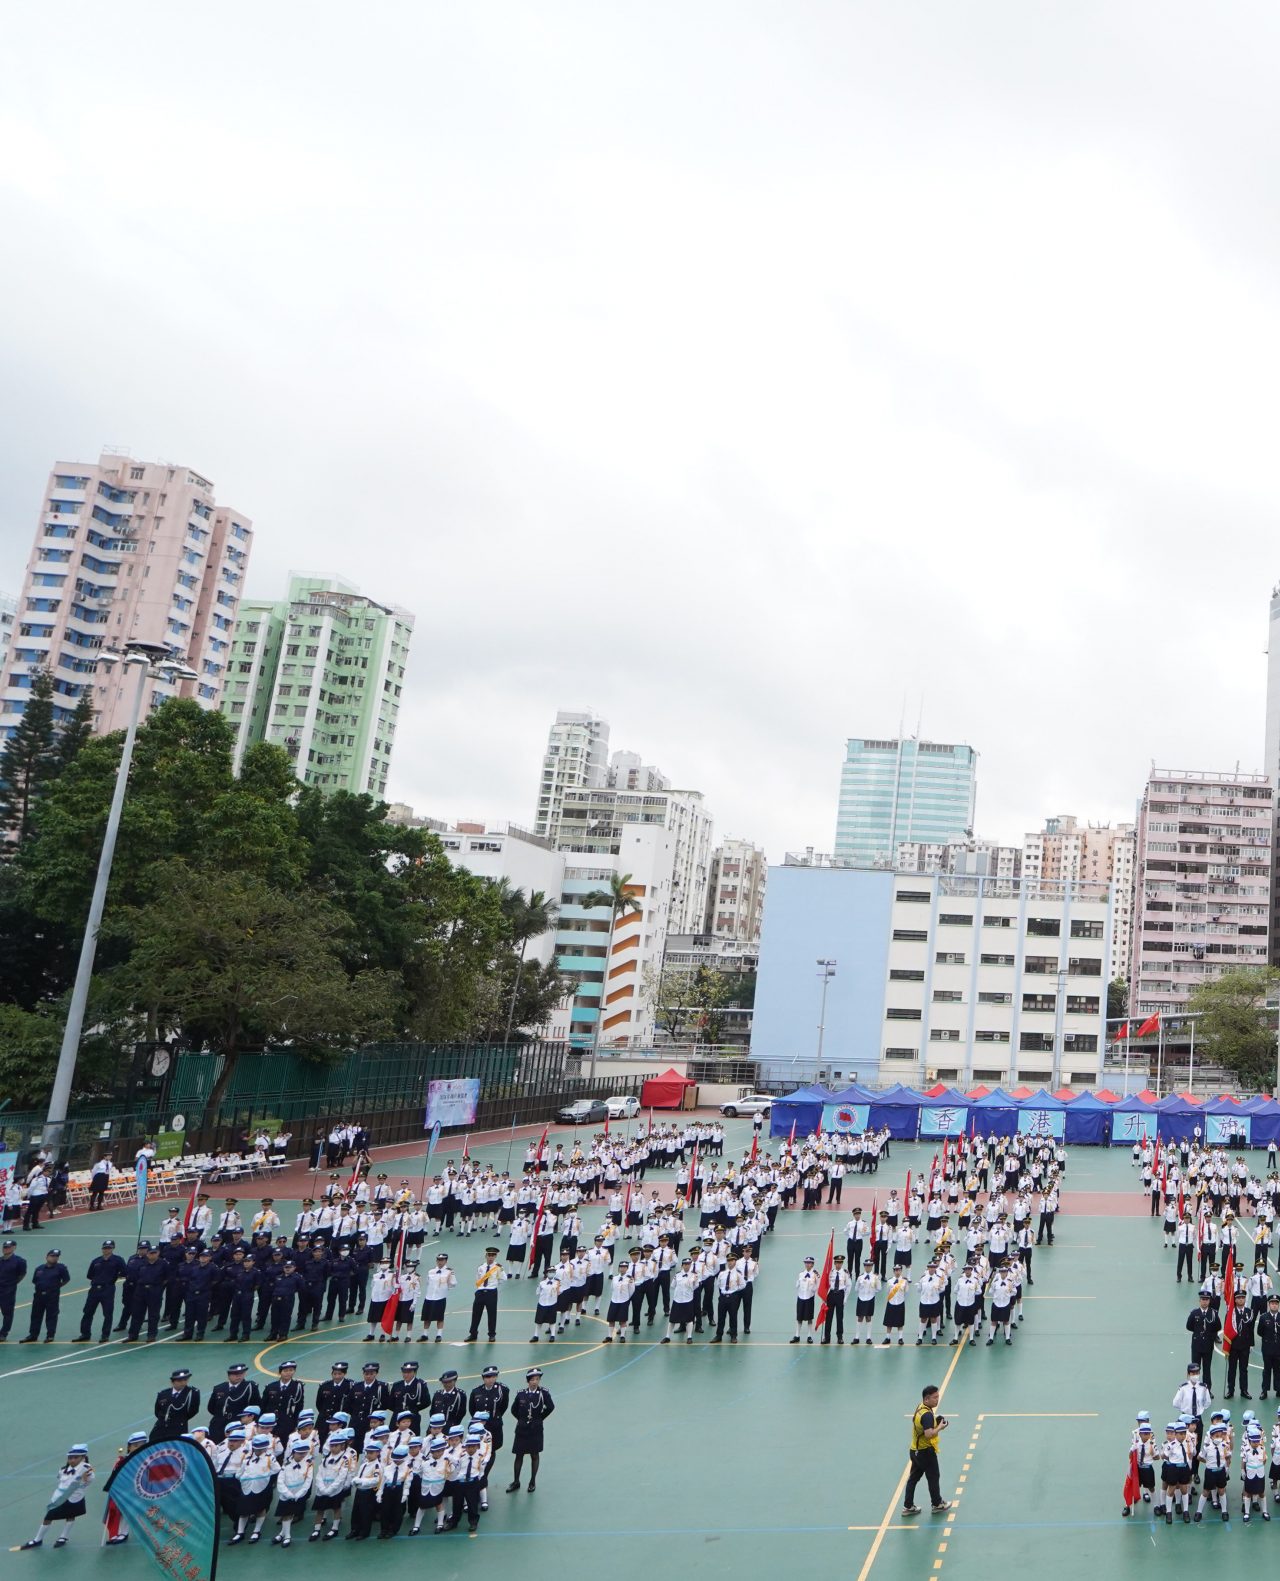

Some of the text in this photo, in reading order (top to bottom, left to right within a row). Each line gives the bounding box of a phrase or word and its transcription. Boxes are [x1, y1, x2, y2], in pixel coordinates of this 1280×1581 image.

[934, 1108, 956, 1131] 香
[1029, 1110, 1052, 1133] 港
[1124, 1113, 1146, 1136] 升
